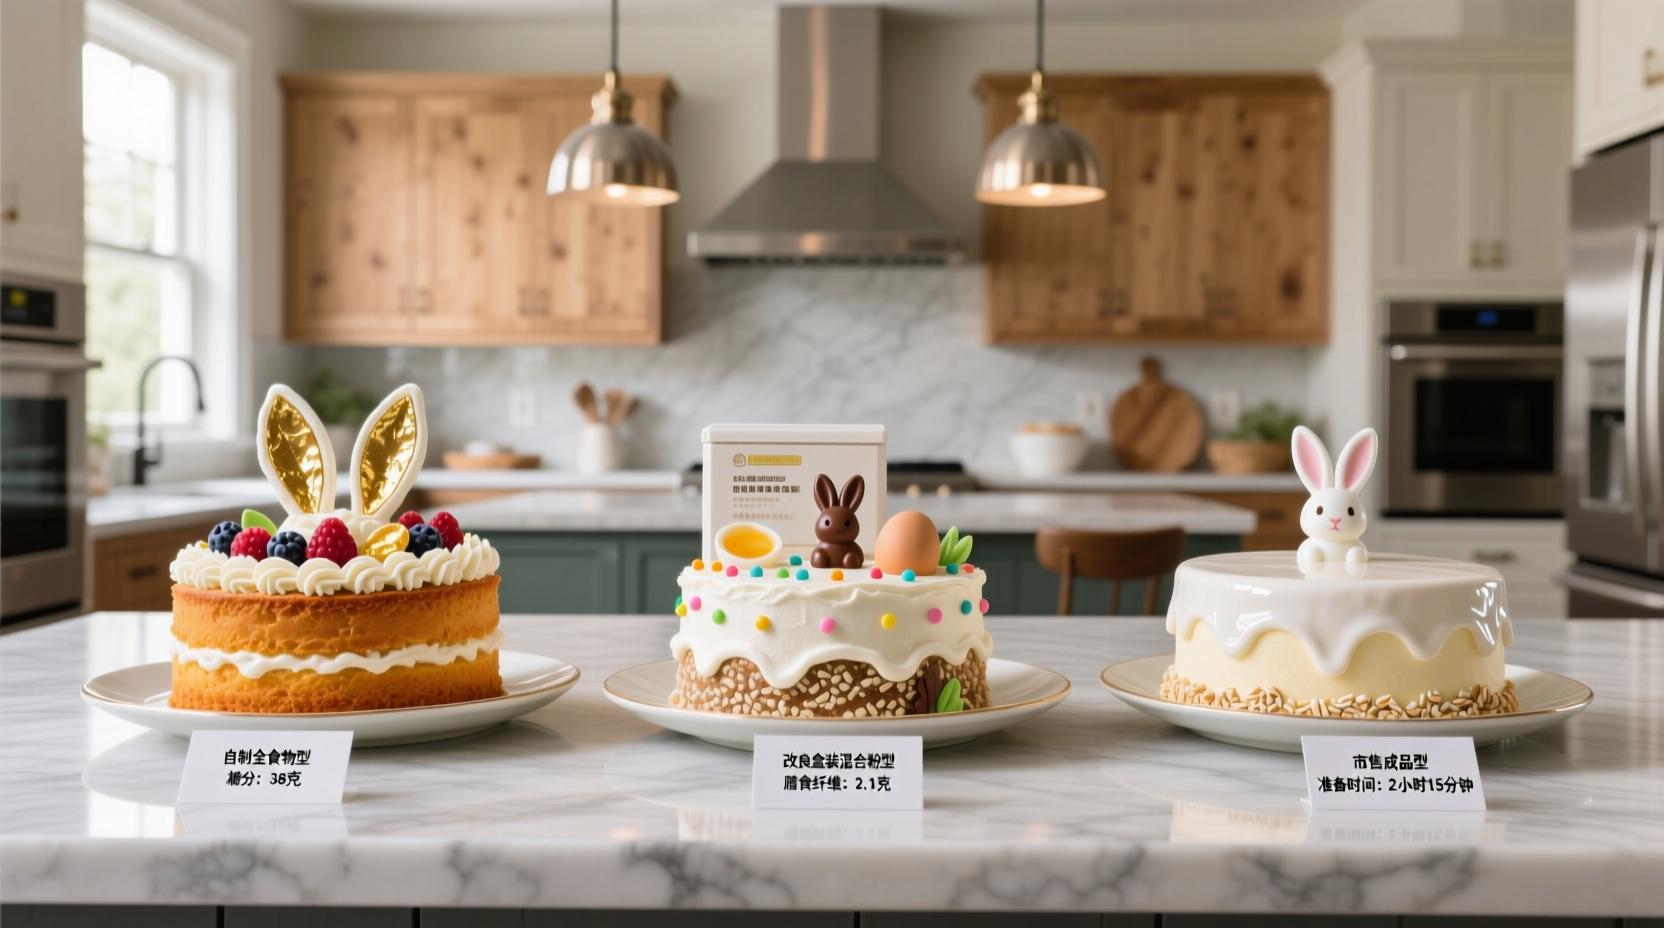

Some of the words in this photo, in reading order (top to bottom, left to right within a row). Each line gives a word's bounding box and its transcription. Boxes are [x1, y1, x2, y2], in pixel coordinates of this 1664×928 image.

[225, 749, 311, 765] 自制全食物型
[1353, 752, 1428, 770] 市售成品型
